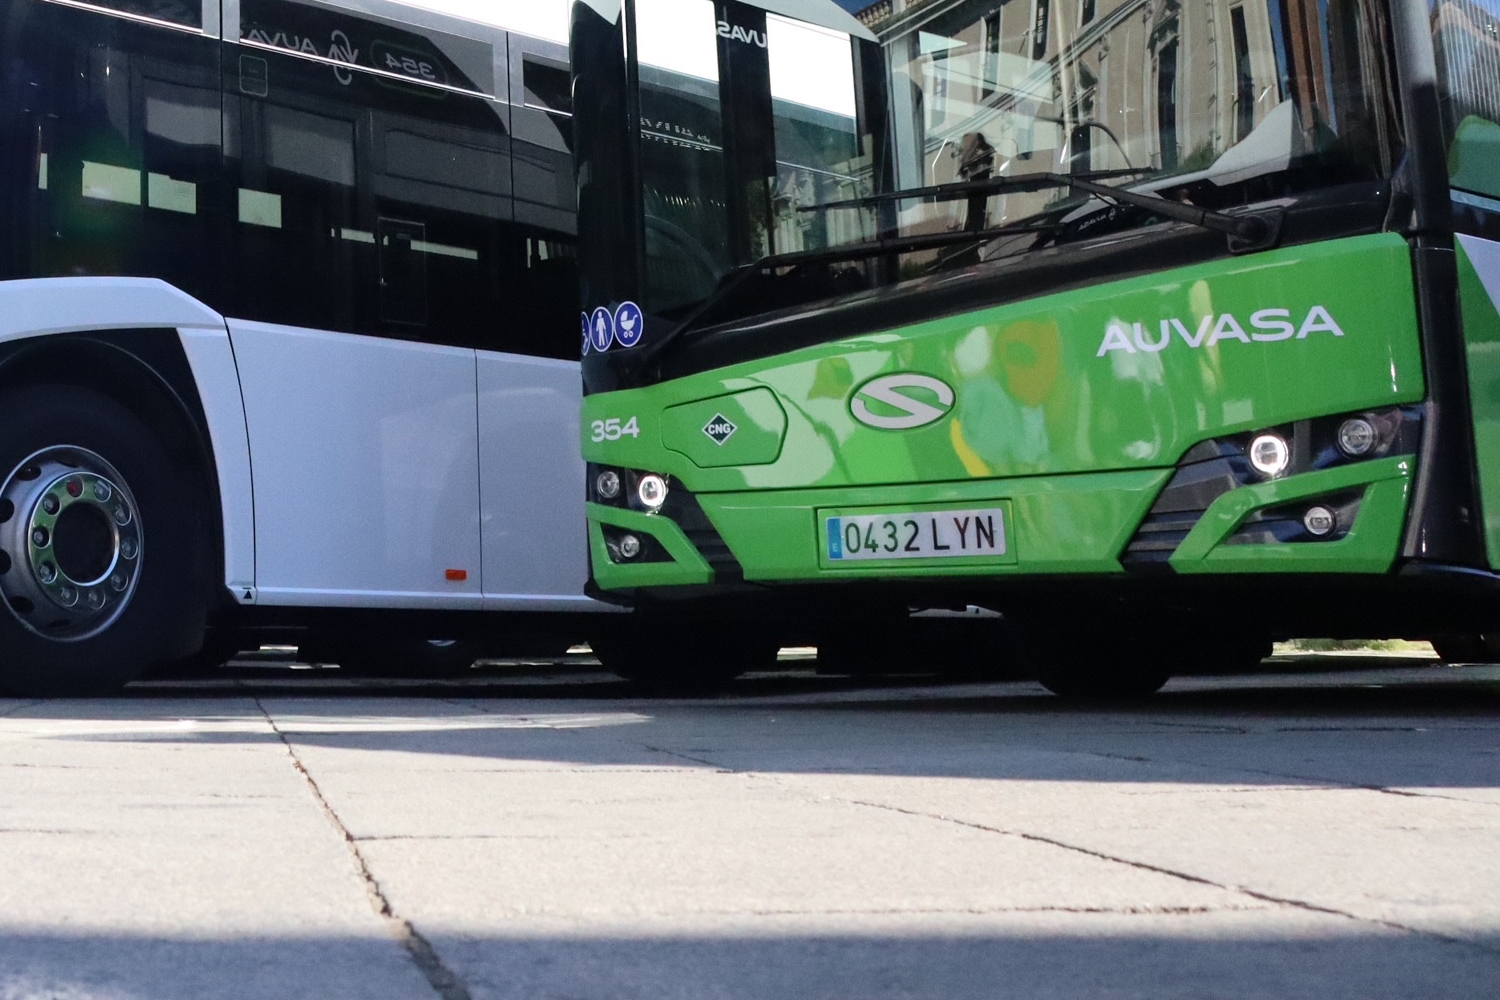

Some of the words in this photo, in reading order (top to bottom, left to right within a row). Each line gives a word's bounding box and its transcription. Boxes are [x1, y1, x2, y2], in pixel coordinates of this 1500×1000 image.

[1096, 305, 1345, 357] AUVASA
[591, 416, 640, 443] 354
[707, 423, 731, 435] CNG
[844, 519, 921, 554] 0432
[931, 515, 995, 551] LYN
